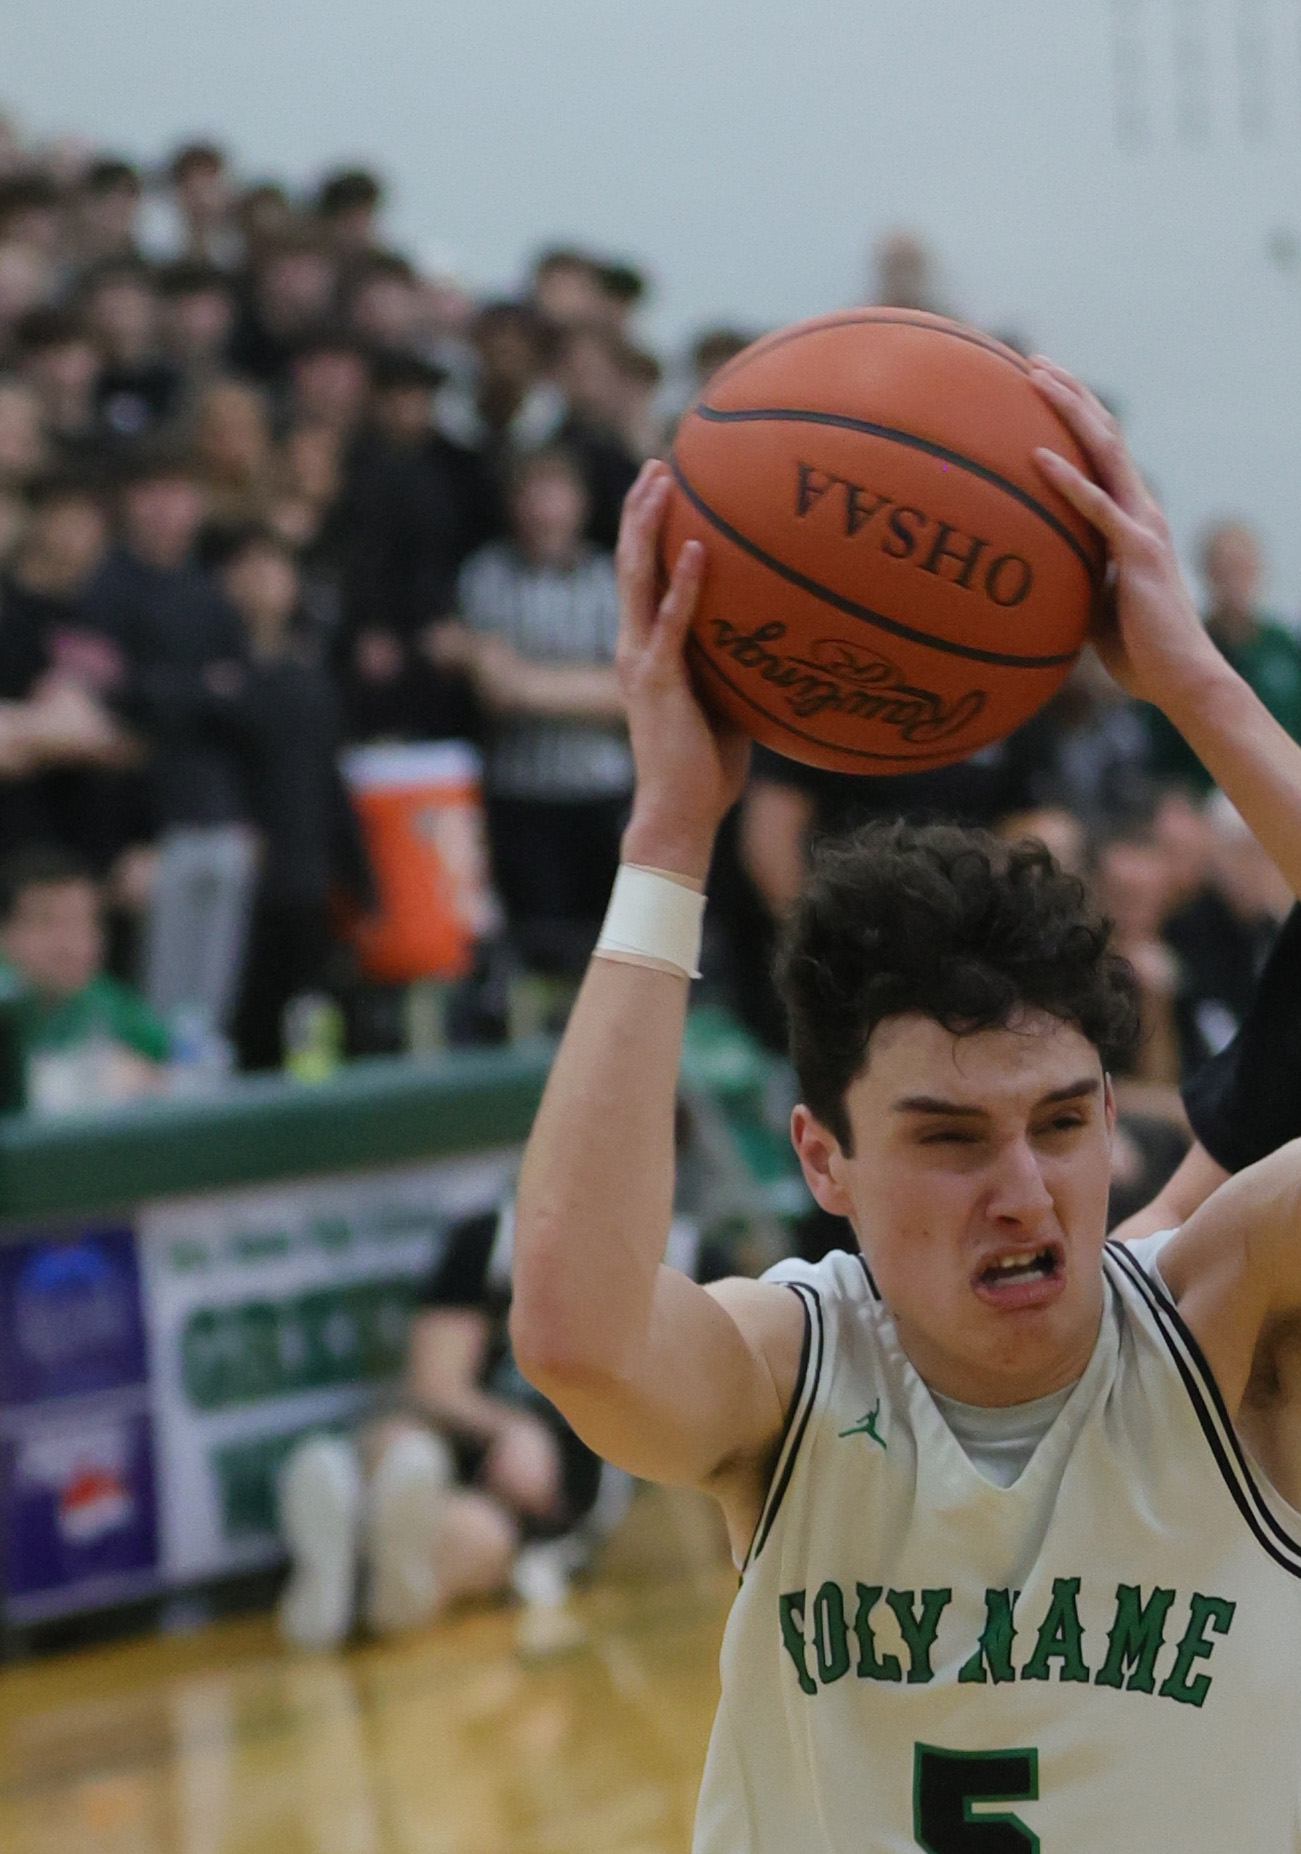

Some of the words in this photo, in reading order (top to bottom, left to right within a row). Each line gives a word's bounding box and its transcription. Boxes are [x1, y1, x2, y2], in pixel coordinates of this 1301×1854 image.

[794, 461, 1034, 607] OHSAA
[709, 618, 987, 744] Rawlings
[957, 1576, 1237, 1708] NAME
